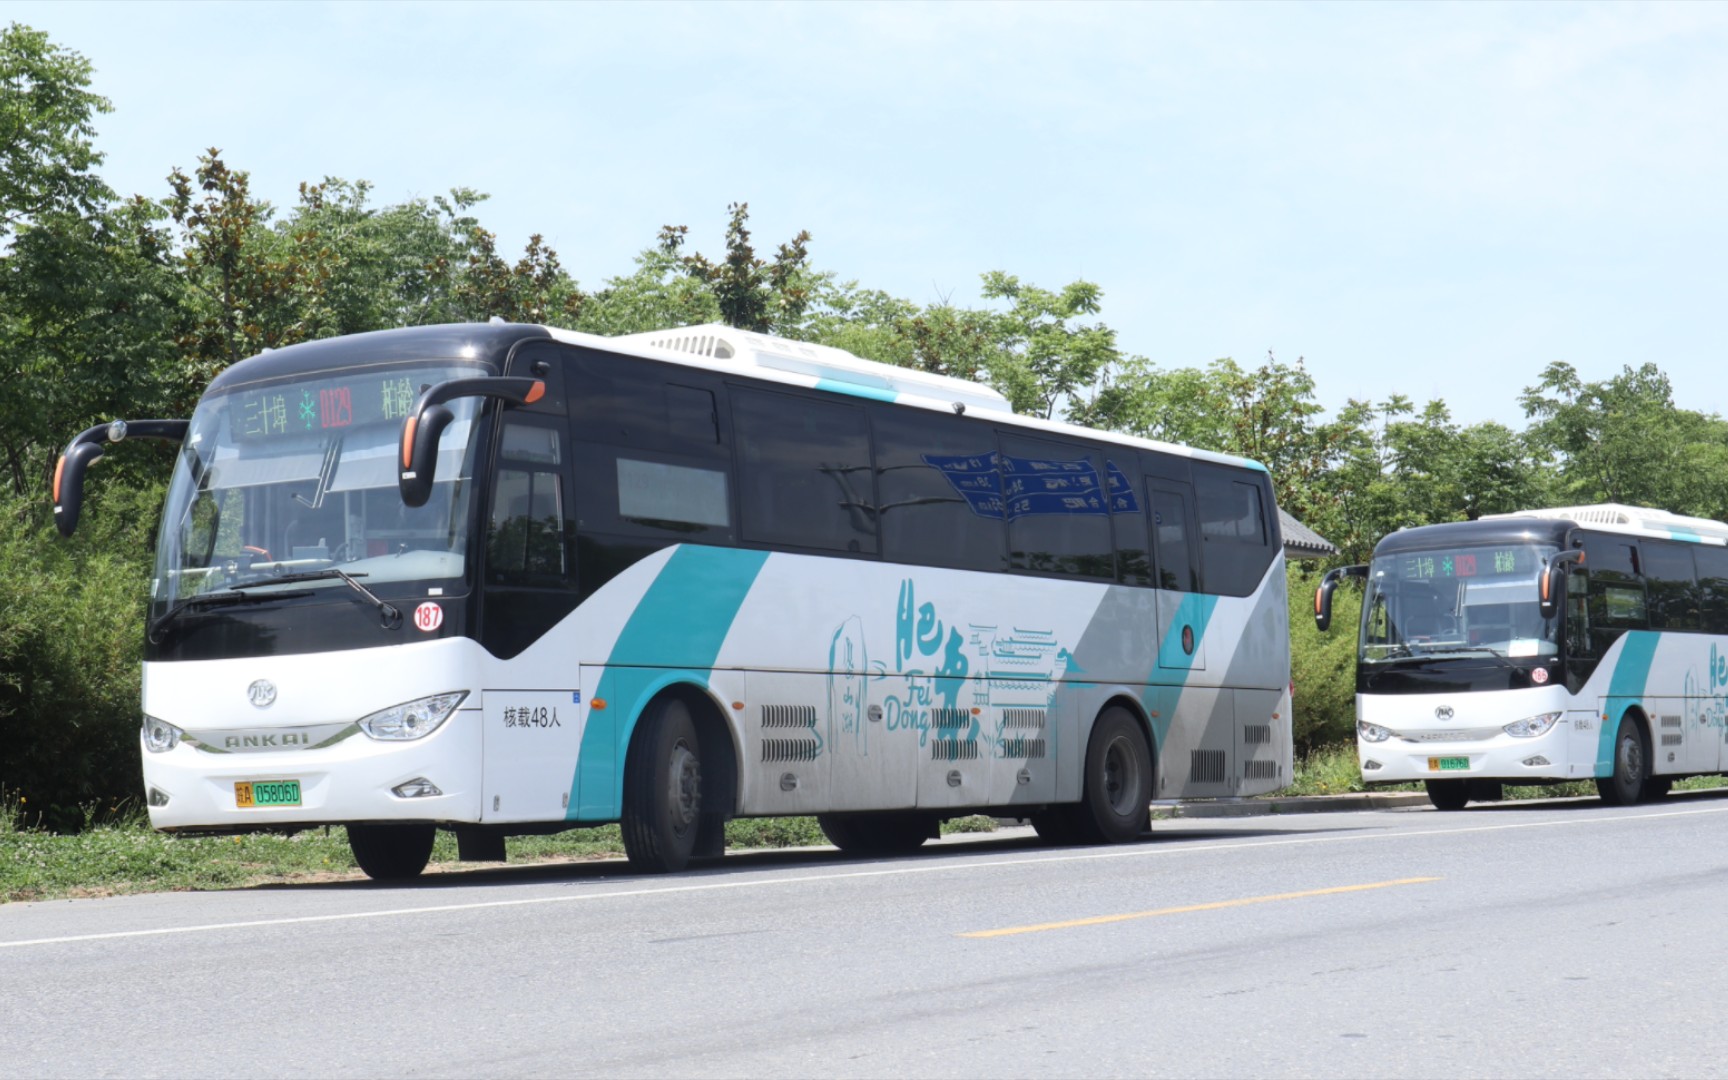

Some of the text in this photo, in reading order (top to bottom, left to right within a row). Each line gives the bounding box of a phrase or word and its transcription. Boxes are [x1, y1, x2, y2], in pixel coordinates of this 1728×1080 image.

[245, 394, 287, 434] 三十埠
[320, 387, 351, 427] 0129
[417, 607, 440, 627] 187
[896, 578, 943, 673] He
[903, 669, 932, 707] Fei
[503, 706, 561, 728] 核载48人
[884, 695, 931, 748] Dong
[225, 733, 309, 748] ANKAI
